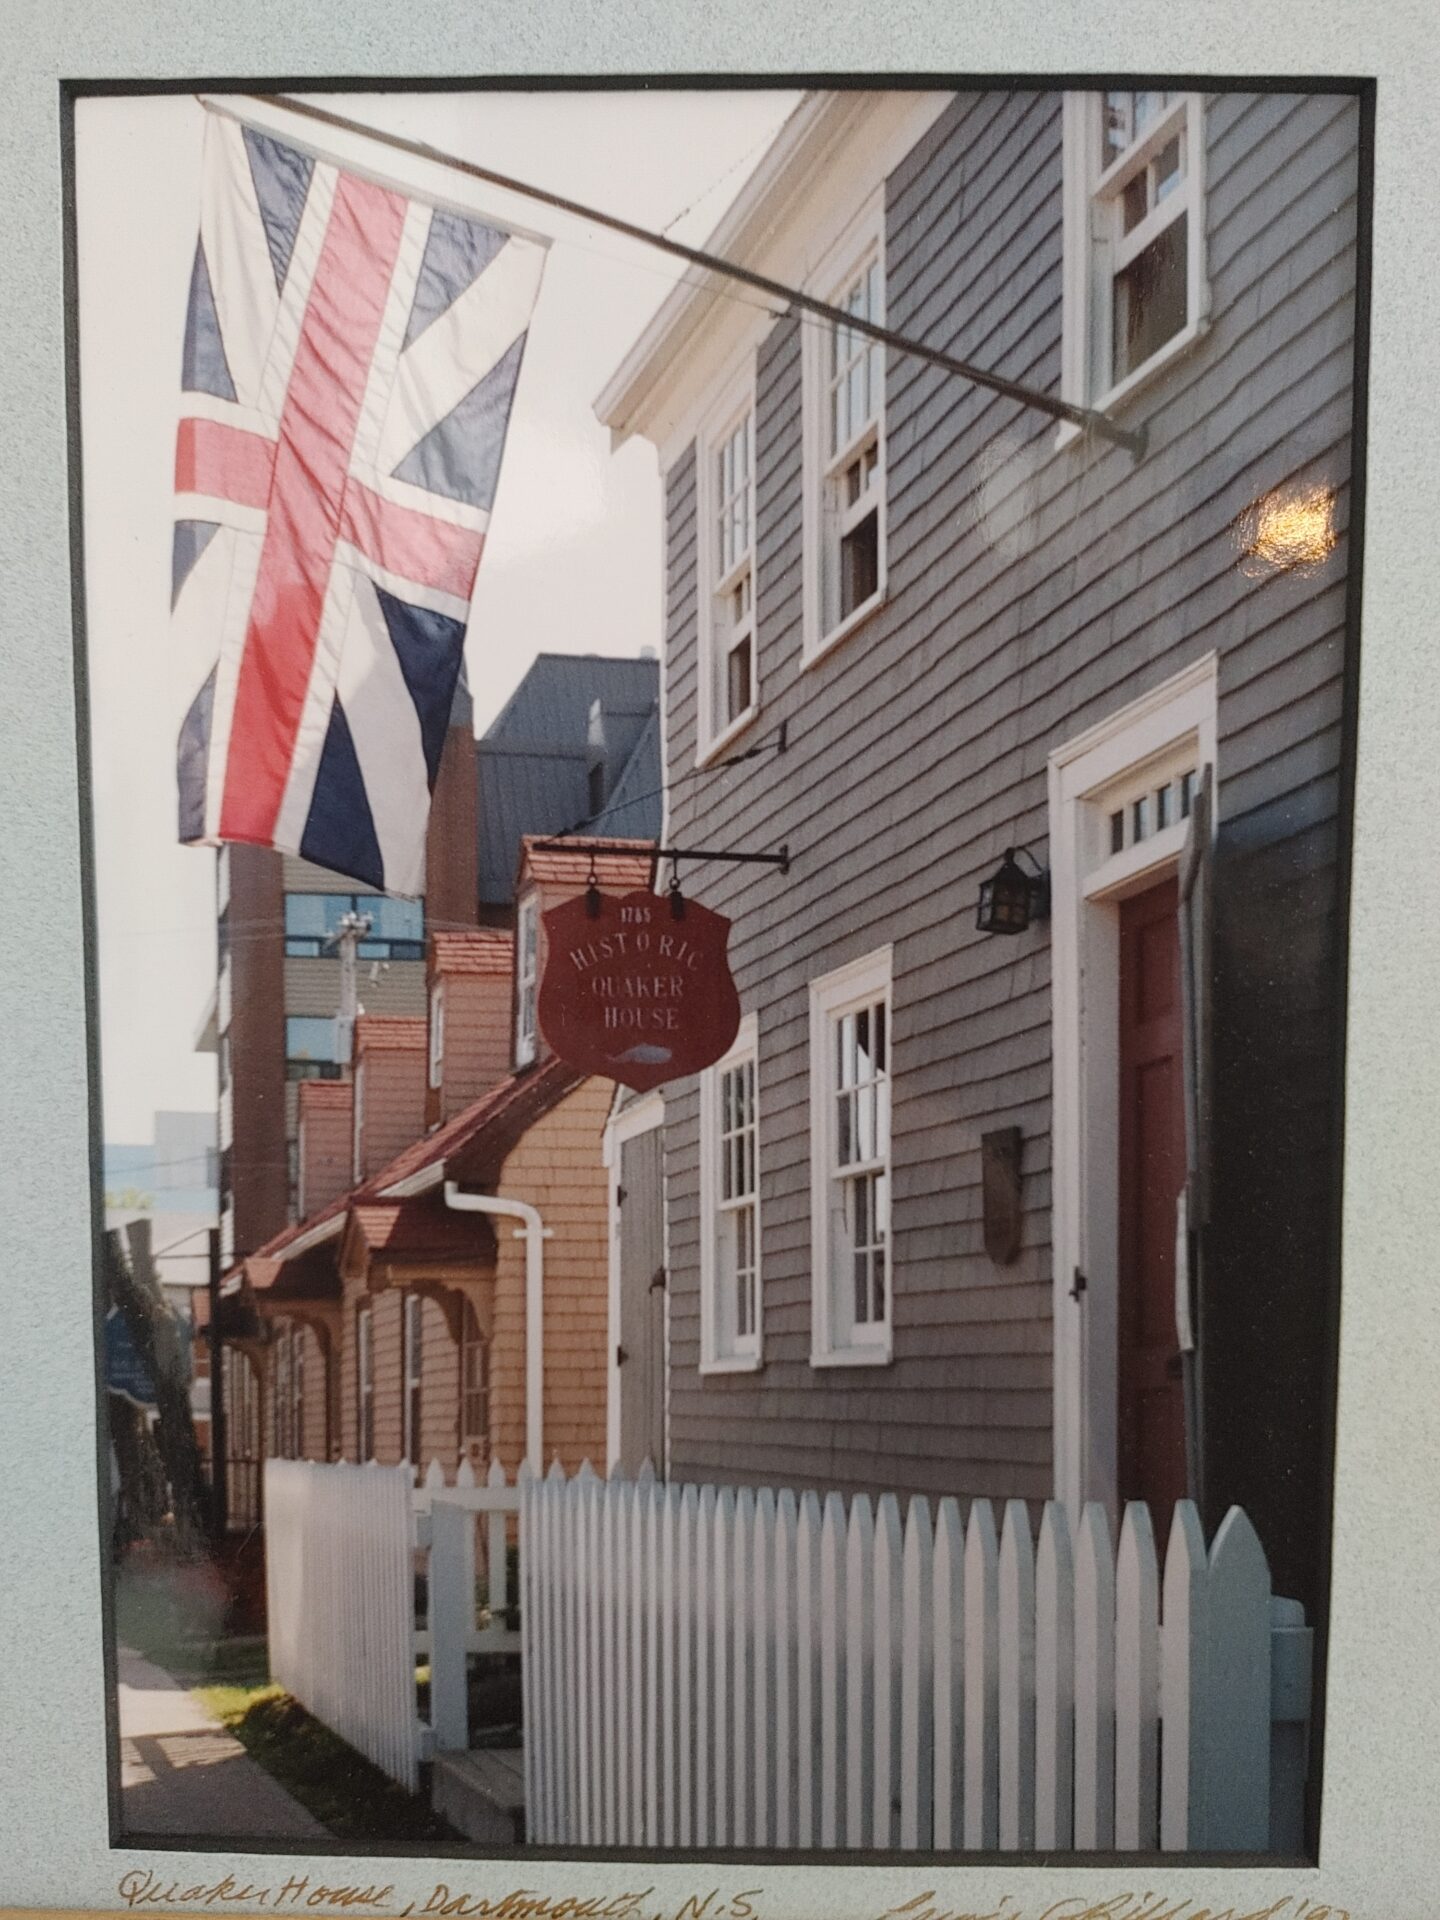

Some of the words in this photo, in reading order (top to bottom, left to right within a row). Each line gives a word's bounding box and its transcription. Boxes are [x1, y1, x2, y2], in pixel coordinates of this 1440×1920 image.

[569, 932, 704, 972] HISTORIC
[591, 976, 684, 999] QUAKER
[604, 1006, 680, 1030] HOUSE
